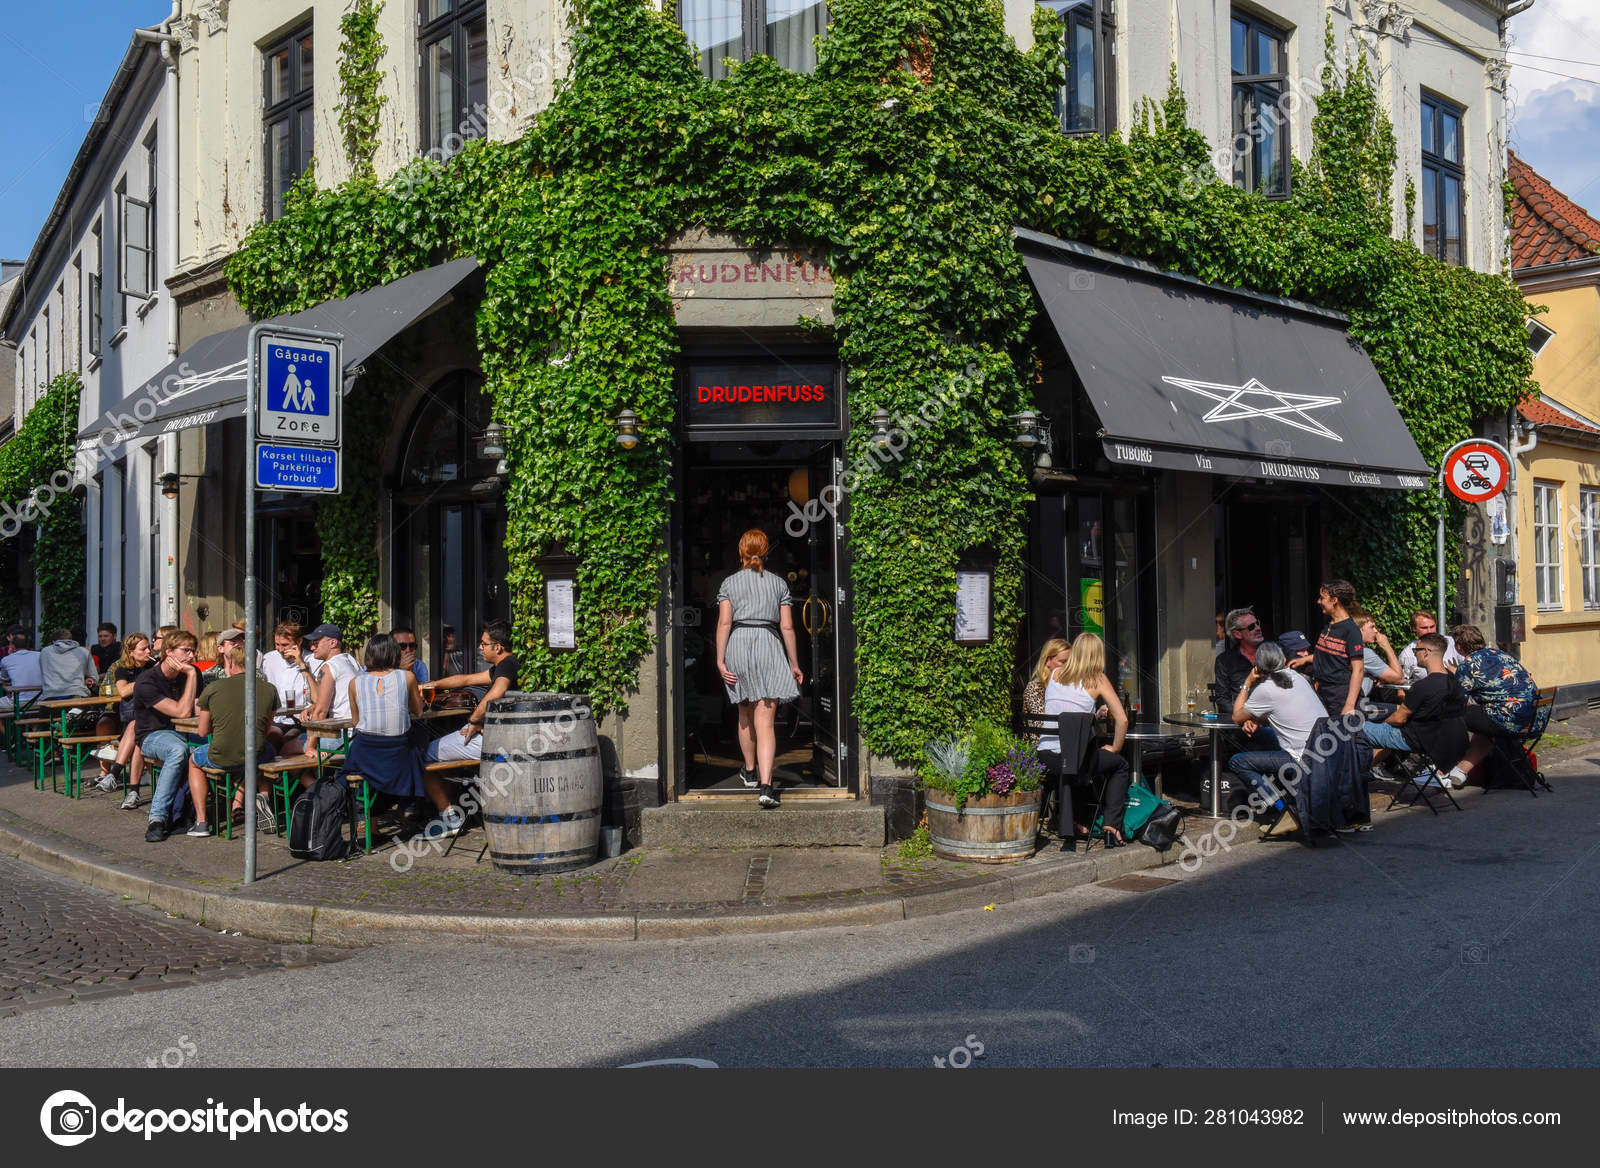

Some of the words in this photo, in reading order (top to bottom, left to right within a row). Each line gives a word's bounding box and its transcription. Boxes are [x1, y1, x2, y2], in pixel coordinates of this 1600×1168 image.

[275, 348, 323, 363] Gågade
[698, 384, 825, 402] DRUDENFUSS
[277, 416, 320, 432] Zone
[262, 450, 296, 461] Kørsel
[300, 453, 332, 464] tilladt
[1115, 443, 1153, 463] TUBORG
[1195, 453, 1212, 469] Vin
[1260, 461, 1320, 480] DRUDENFUSS
[1349, 471, 1381, 485] Cocktails
[273, 461, 321, 474] Parkering
[278, 472, 317, 483] forbudt
[534, 777, 555, 793] LUIS
